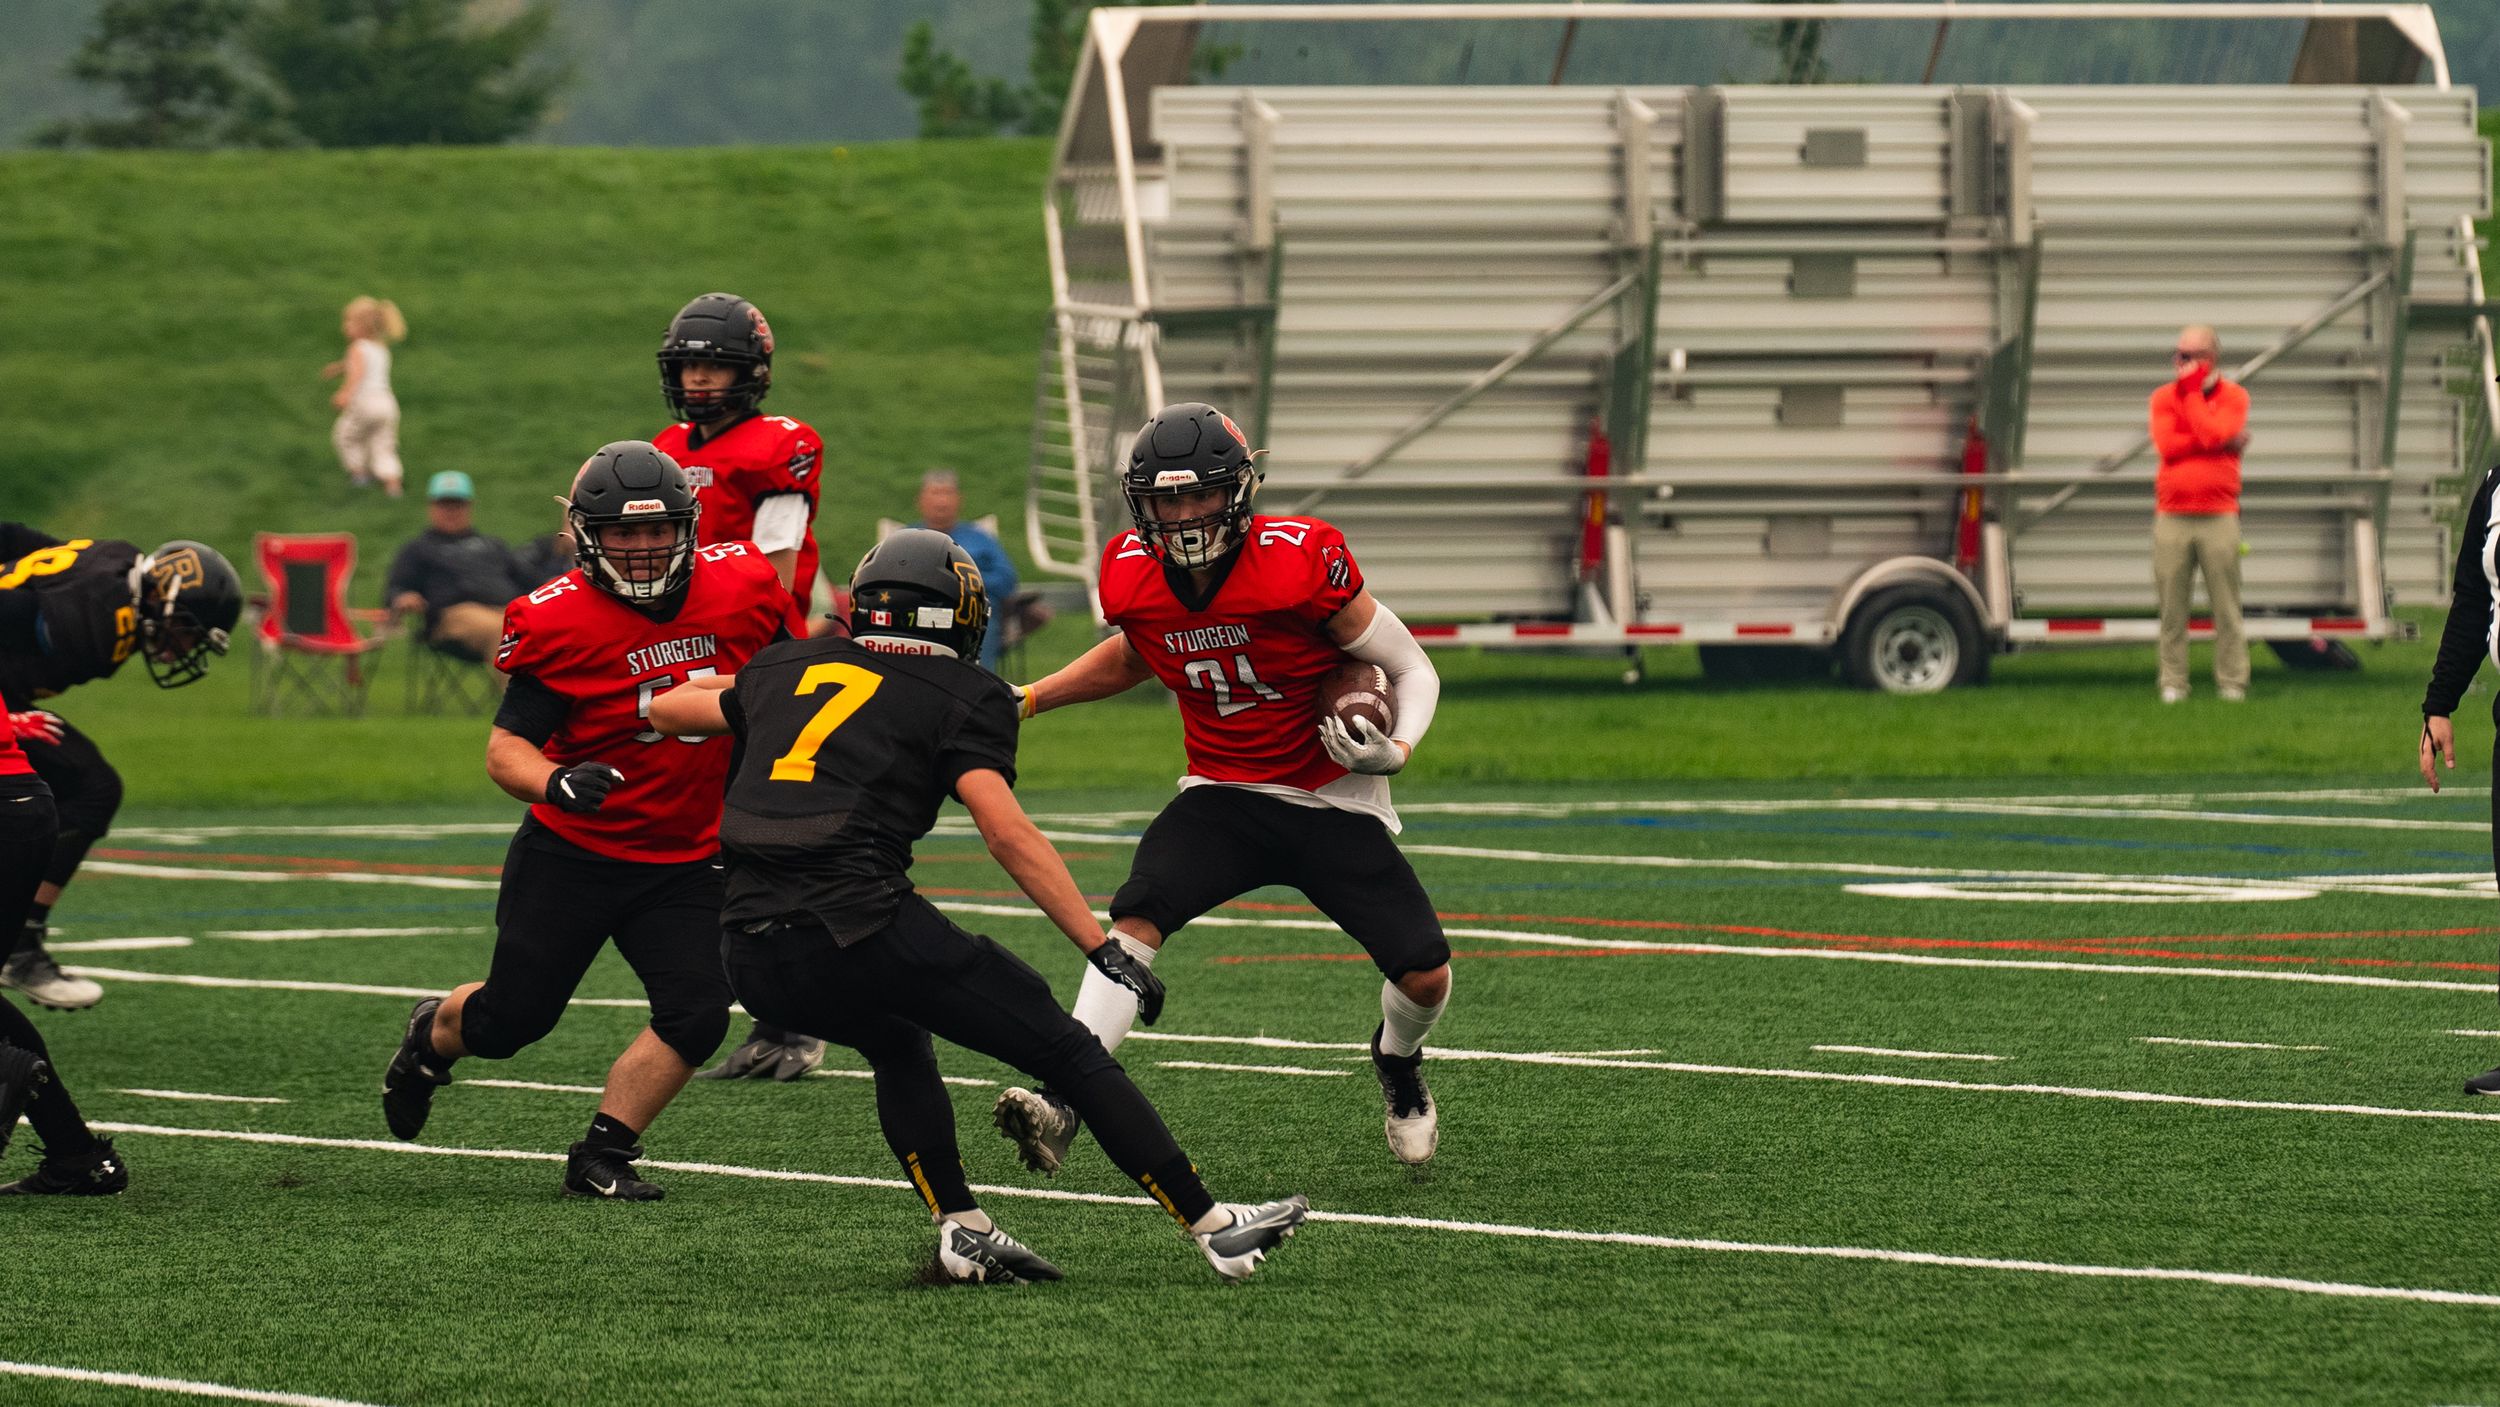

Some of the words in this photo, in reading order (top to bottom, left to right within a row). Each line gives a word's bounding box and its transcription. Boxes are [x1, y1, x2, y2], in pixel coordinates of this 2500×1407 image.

[628, 502, 661, 511] Riddell
[1259, 521, 1311, 547] 21
[908, 612, 915, 627] 7
[865, 640, 932, 656] Riddell
[1164, 624, 1251, 654] STURGEON
[627, 634, 717, 675] STURGEON
[1184, 654, 1284, 717] 21
[634, 666, 718, 742] 5
[768, 662, 884, 783] 7
